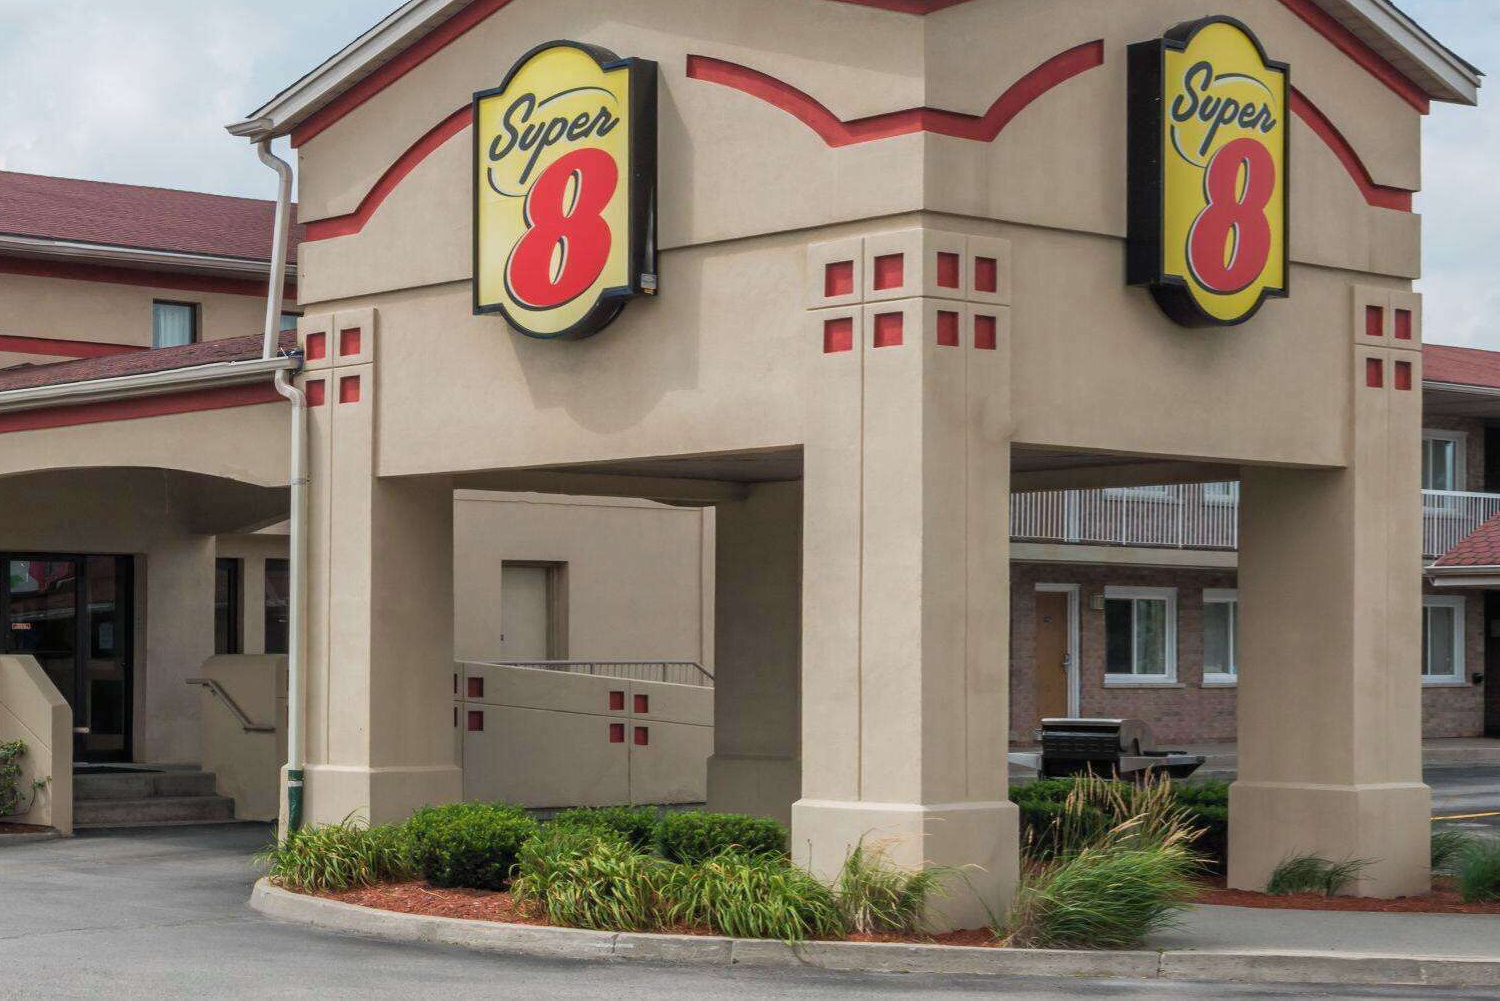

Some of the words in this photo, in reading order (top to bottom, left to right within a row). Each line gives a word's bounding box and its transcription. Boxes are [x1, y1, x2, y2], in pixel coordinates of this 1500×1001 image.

[488, 92, 620, 186] Super
[1171, 61, 1276, 157] Super
[503, 147, 618, 311] 8
[1185, 137, 1275, 295] 8
